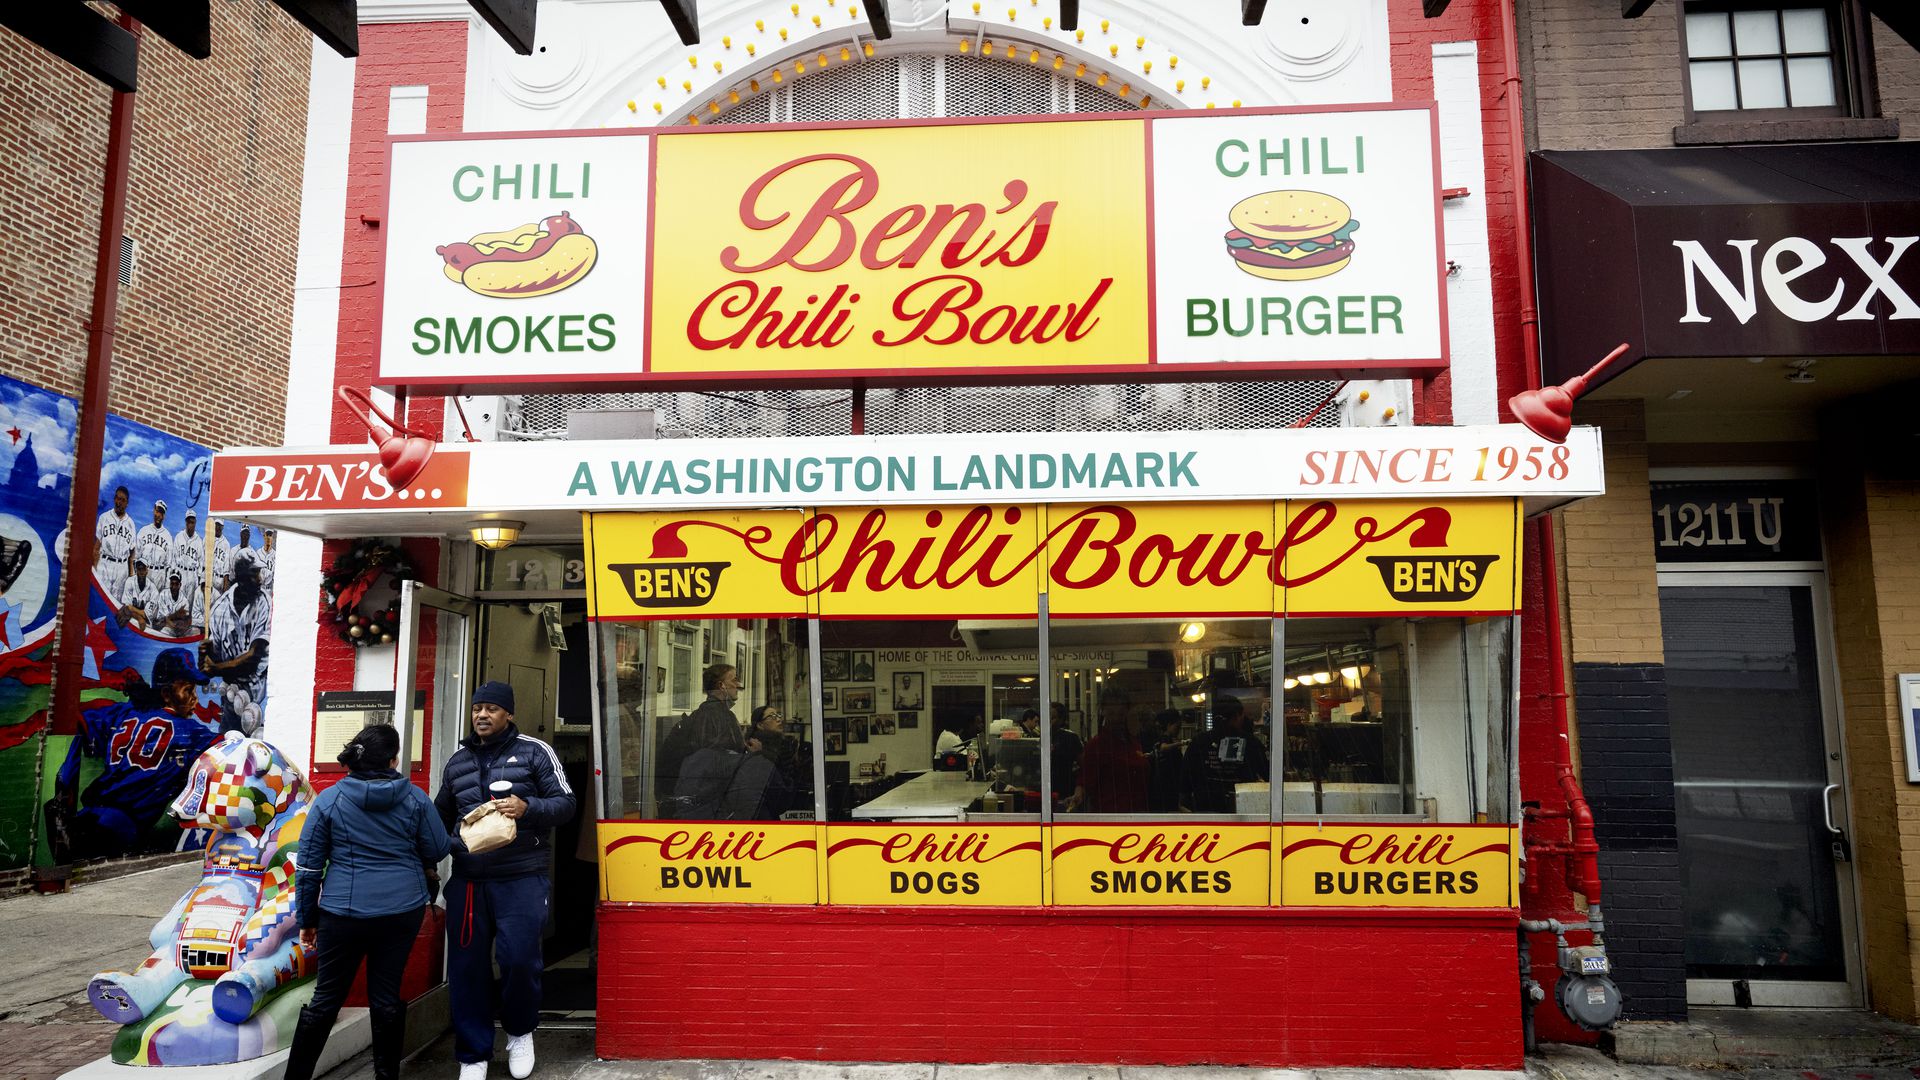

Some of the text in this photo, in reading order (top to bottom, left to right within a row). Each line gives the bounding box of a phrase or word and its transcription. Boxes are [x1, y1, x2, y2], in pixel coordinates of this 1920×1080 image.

[1215, 136, 1364, 178] CHILI
[452, 162, 591, 202] CHILI
[719, 153, 1058, 273] Ben's
[686, 274, 1114, 351] Chili Bowl
[1186, 295, 1404, 337] BURGER
[411, 313, 617, 355] SMOKES
[566, 451, 1200, 496] A WASHINGTON LANDMARK
[1299, 445, 1571, 486] SINCE 1958
[103, 523, 133, 545] GRAYS
[780, 500, 1340, 598] Chili Bowl
[505, 559, 585, 583] 123
[633, 566, 712, 599] BEN'S
[1393, 558, 1477, 593] BEN'S
[878, 651, 911, 662] HOME
[914, 651, 929, 662] OF
[933, 650, 953, 662] THE
[110, 716, 174, 771] 20
[657, 831, 772, 861] Chili
[881, 833, 994, 864] Chili
[1109, 833, 1226, 863] Chili
[1339, 834, 1459, 865] Chili
[661, 866, 752, 889] BOWL
[890, 871, 980, 895] DOGS
[1090, 870, 1232, 894] SMOKES
[1314, 870, 1479, 895] BURGERS
